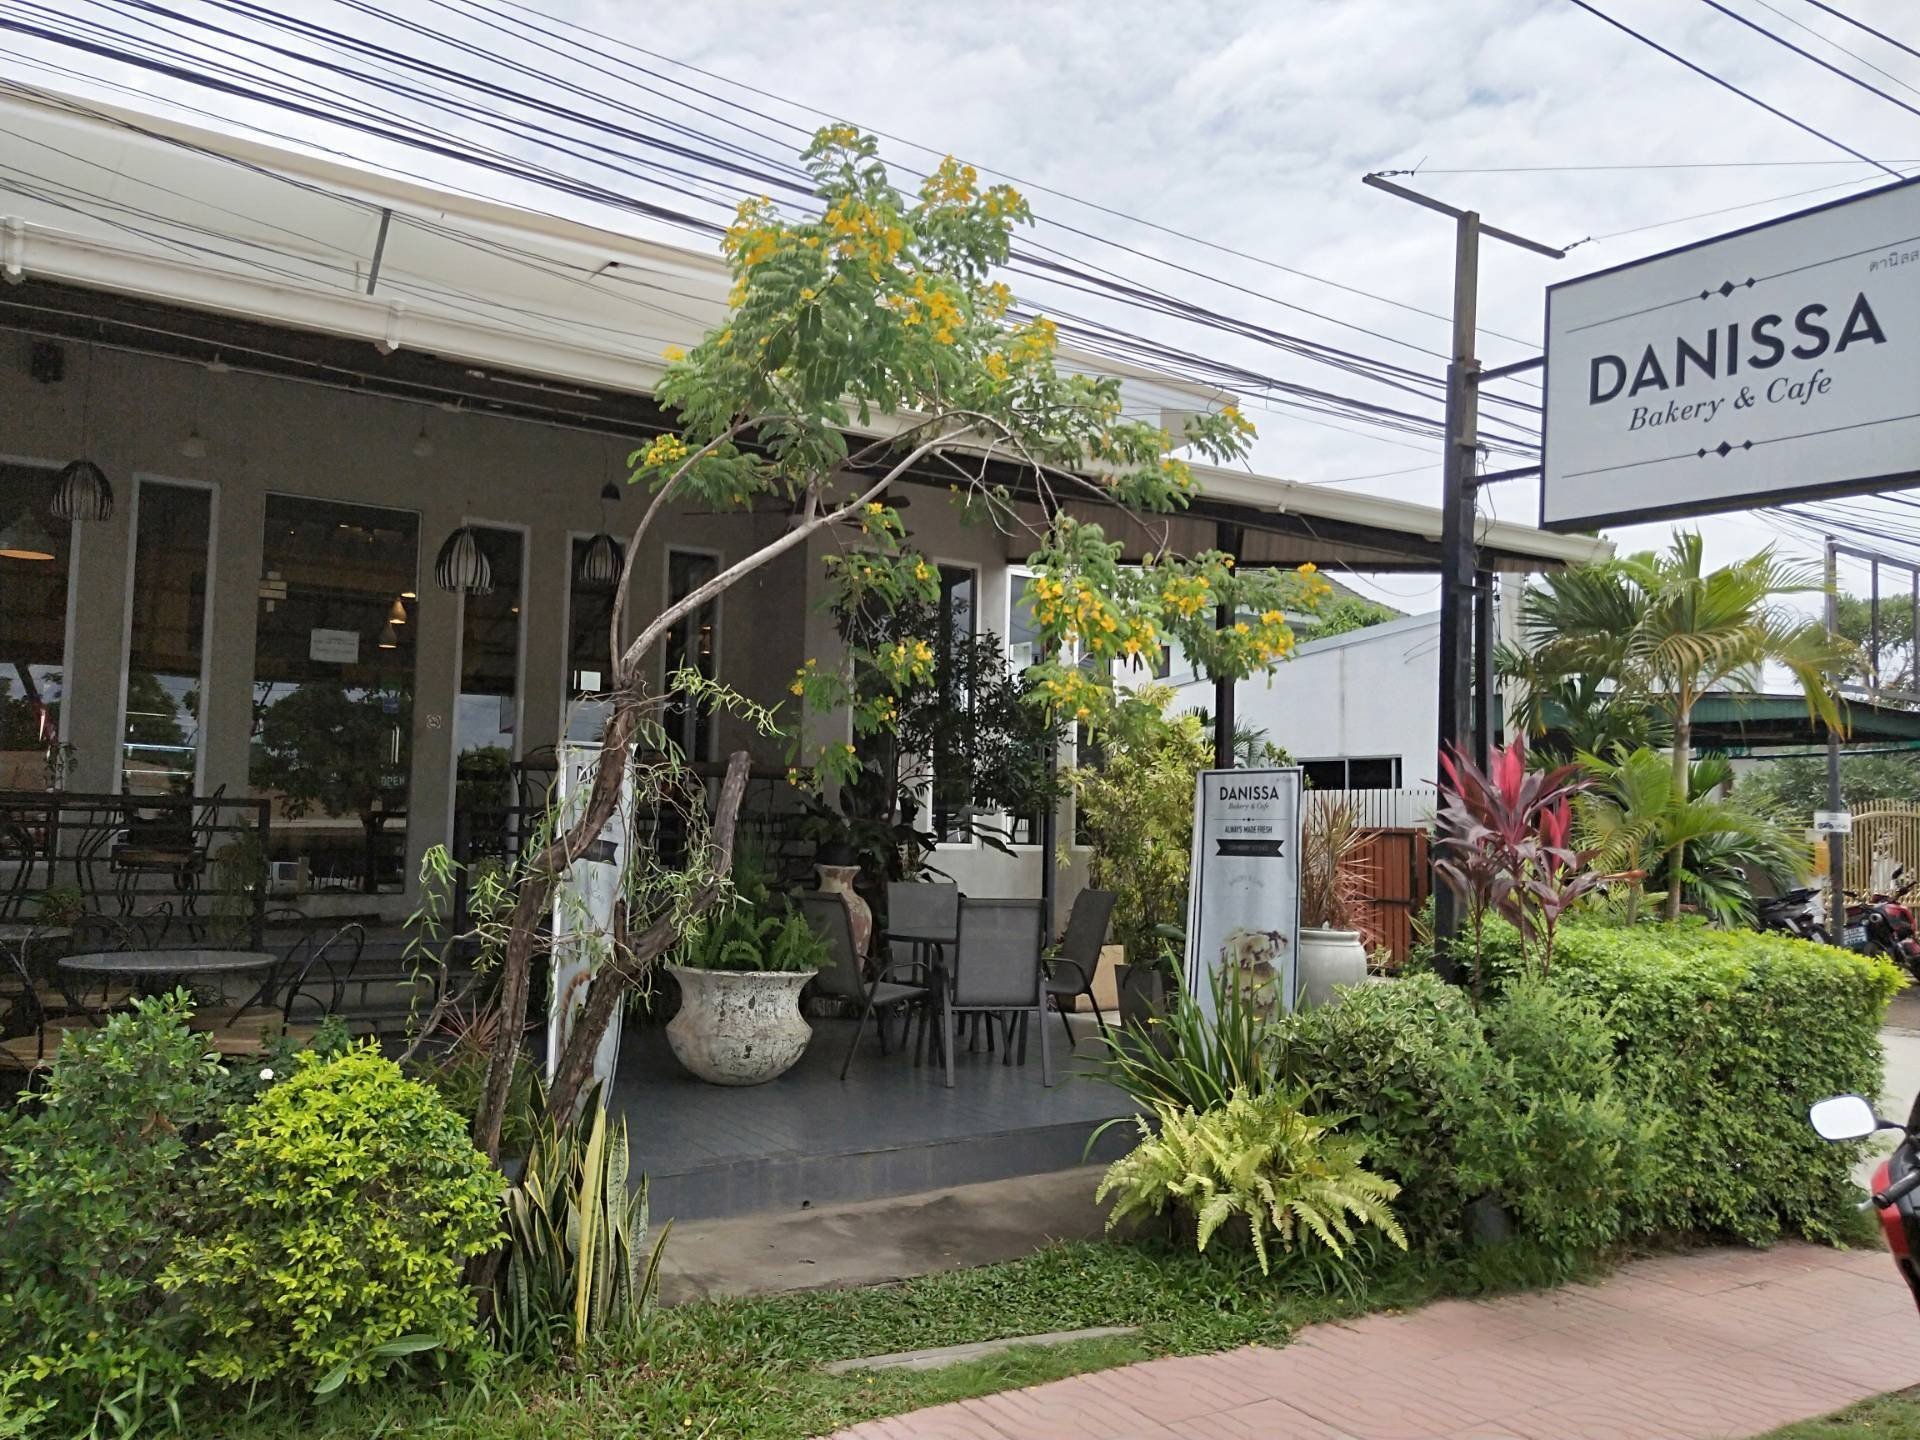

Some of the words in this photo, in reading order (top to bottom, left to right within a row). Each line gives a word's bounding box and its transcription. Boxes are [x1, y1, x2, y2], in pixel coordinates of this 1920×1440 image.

[1589, 292, 1887, 406] DANISSA
[1628, 400, 1725, 431] Bakery
[1734, 387, 1755, 410] &
[1766, 369, 1832, 405] Cafe
[1220, 786, 1279, 801] DANISSA
[1225, 825, 1242, 833] ALWAYS
[1243, 825, 1256, 833] MADE
[1257, 825, 1272, 833] FRESH
